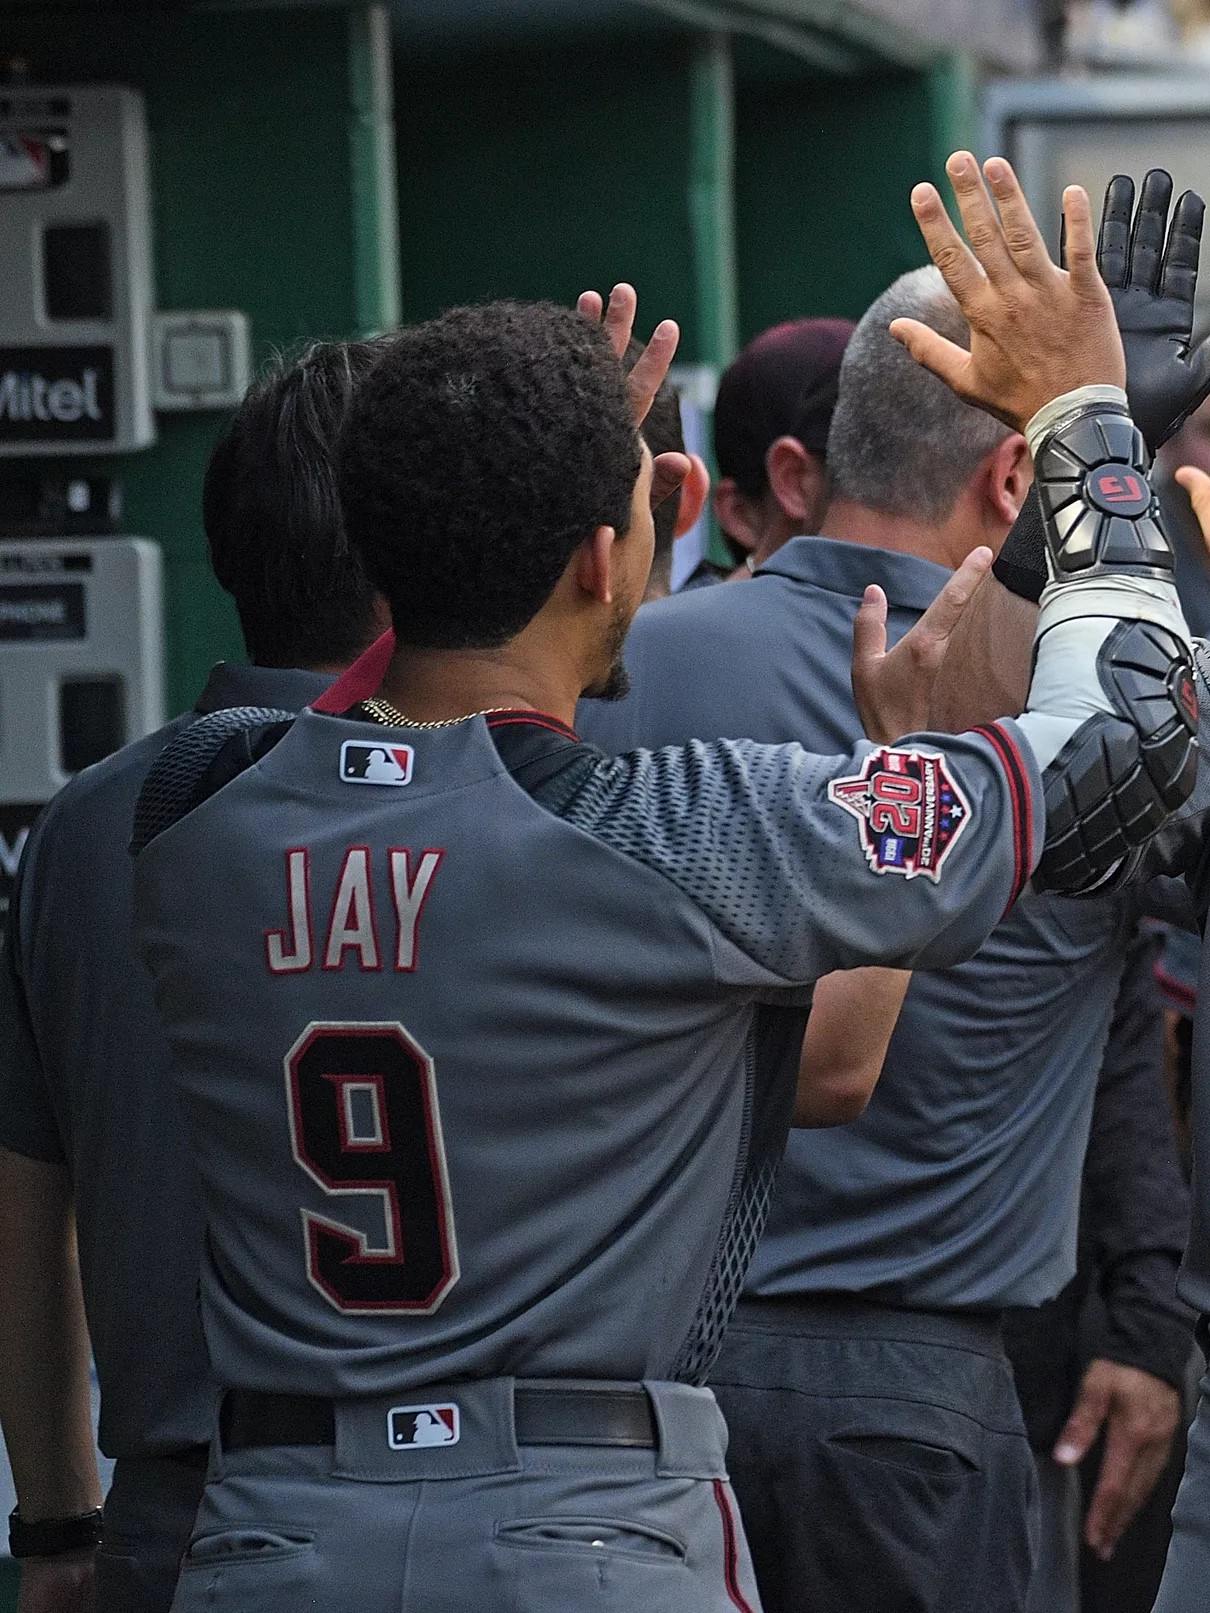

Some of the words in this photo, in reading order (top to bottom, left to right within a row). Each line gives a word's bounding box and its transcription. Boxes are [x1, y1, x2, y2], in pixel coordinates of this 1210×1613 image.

[869, 771, 922, 839] 20
[265, 845, 447, 974] JAY
[283, 1020, 461, 1316] 9
